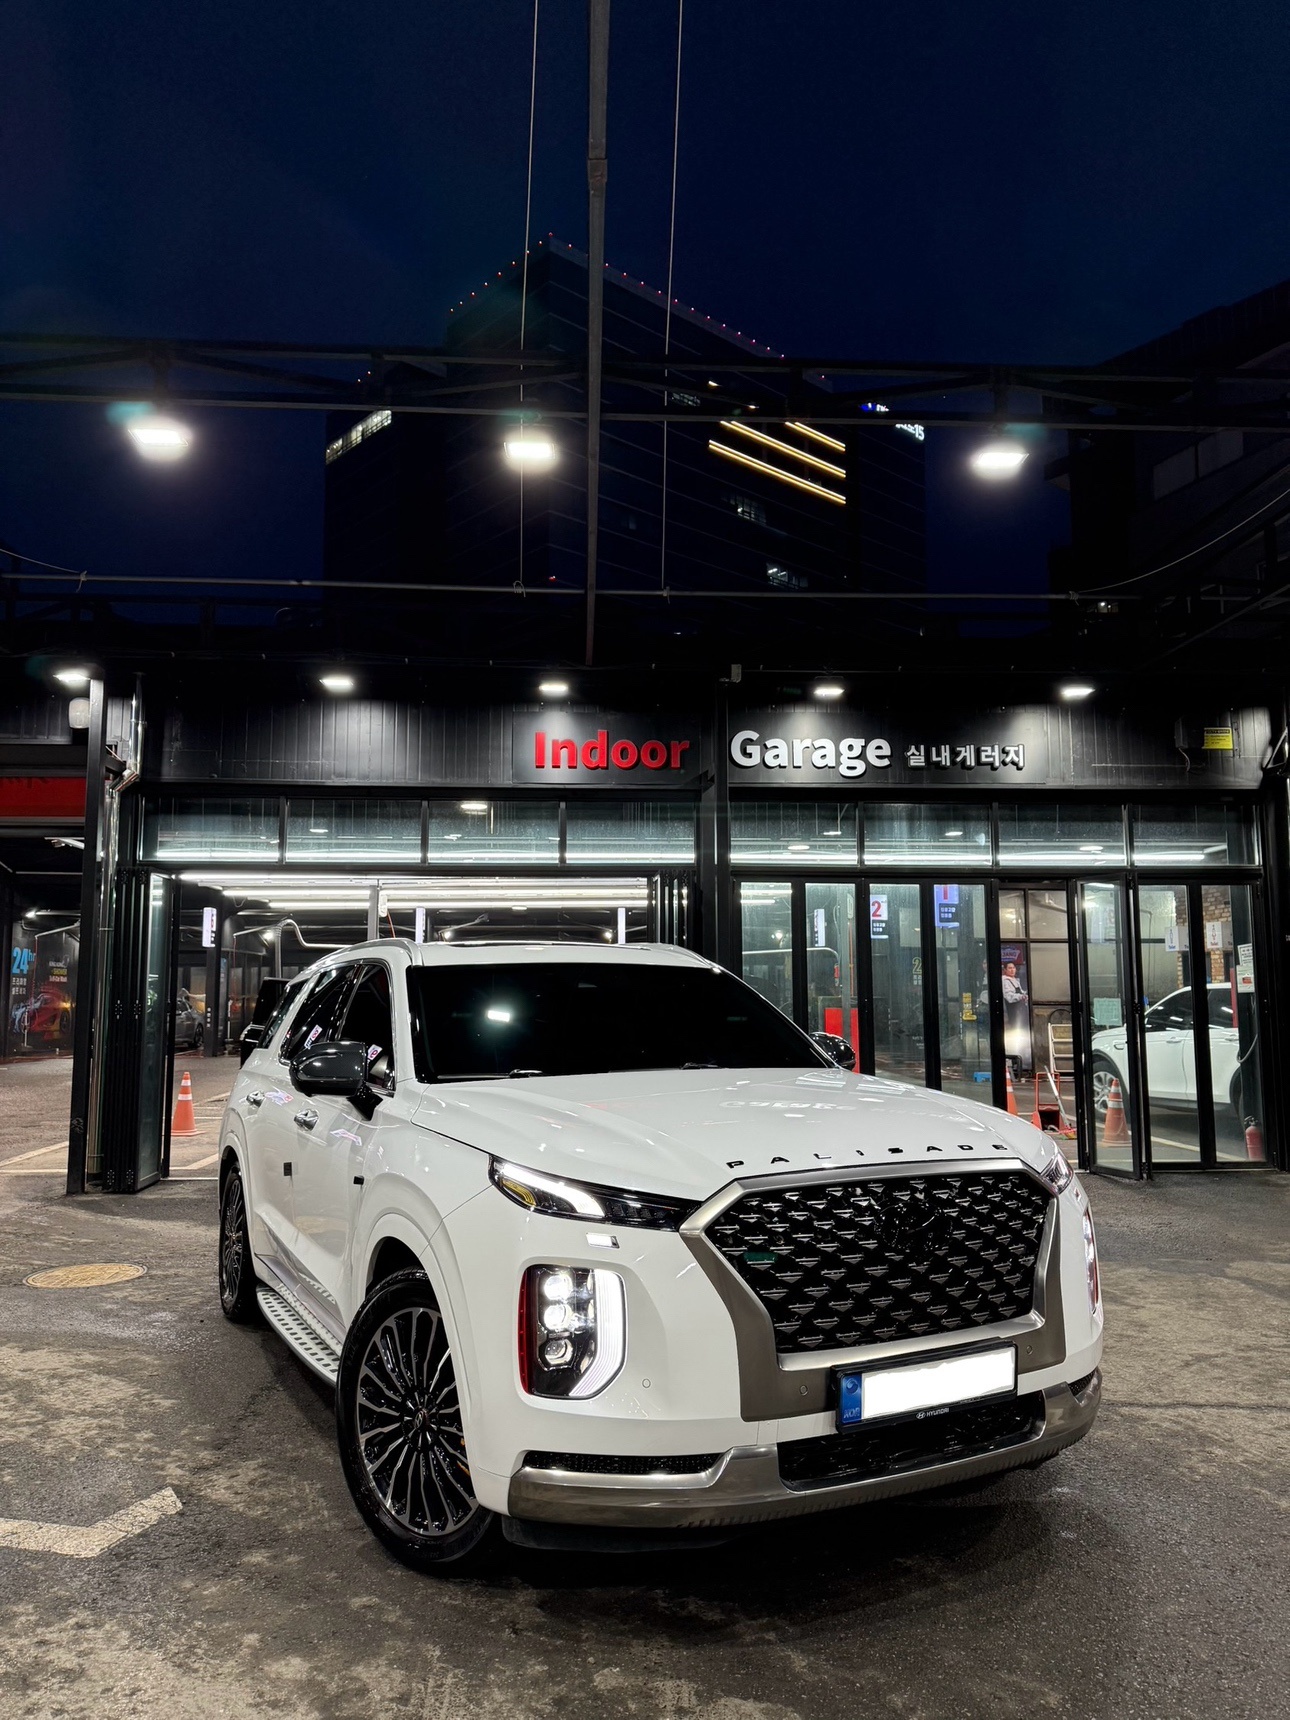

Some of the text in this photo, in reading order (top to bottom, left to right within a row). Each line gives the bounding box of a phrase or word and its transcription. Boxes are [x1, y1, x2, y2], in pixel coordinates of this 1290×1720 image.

[535, 729, 1025, 777] Indoor Garage 실내게러지
[871, 901, 882, 918] 2
[726, 1144, 1008, 1169] PALISADE
